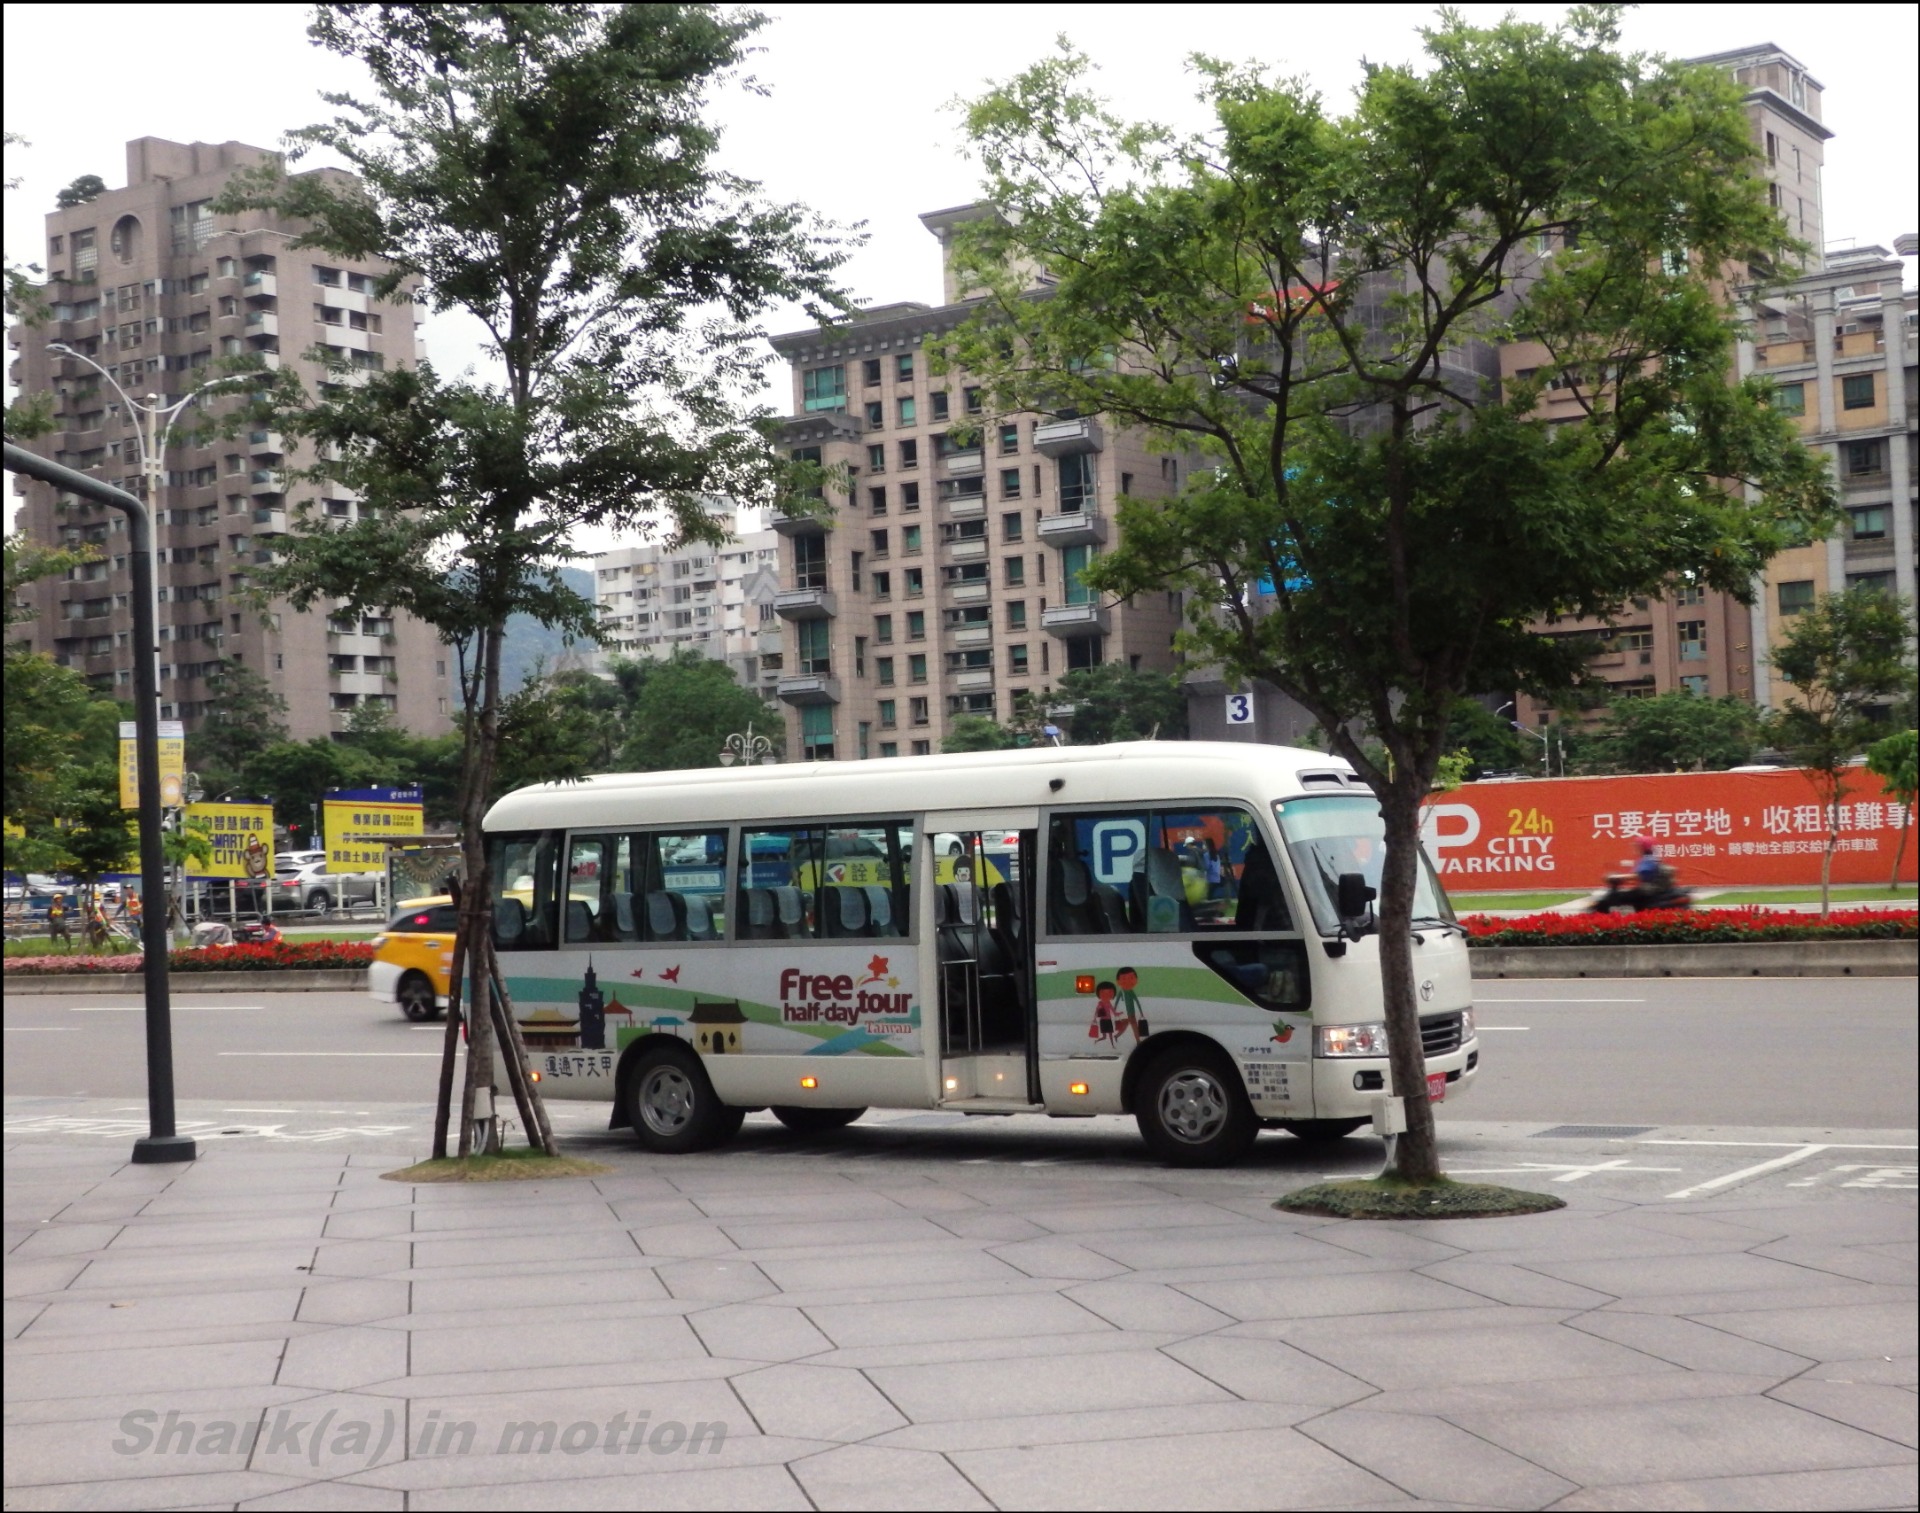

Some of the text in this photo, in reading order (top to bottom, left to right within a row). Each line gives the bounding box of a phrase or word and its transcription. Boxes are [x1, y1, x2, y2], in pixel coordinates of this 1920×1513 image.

[1230, 695, 1249, 722] 3
[1508, 808, 1554, 835] 24h
[208, 833, 245, 850] SMART
[1100, 828, 1138, 876] P
[1487, 836, 1553, 855] CITY
[214, 849, 243, 865] CITY
[780, 967, 854, 1001] Free
[784, 989, 913, 1026] half-day tour
[864, 1020, 912, 1034] Taiwan
